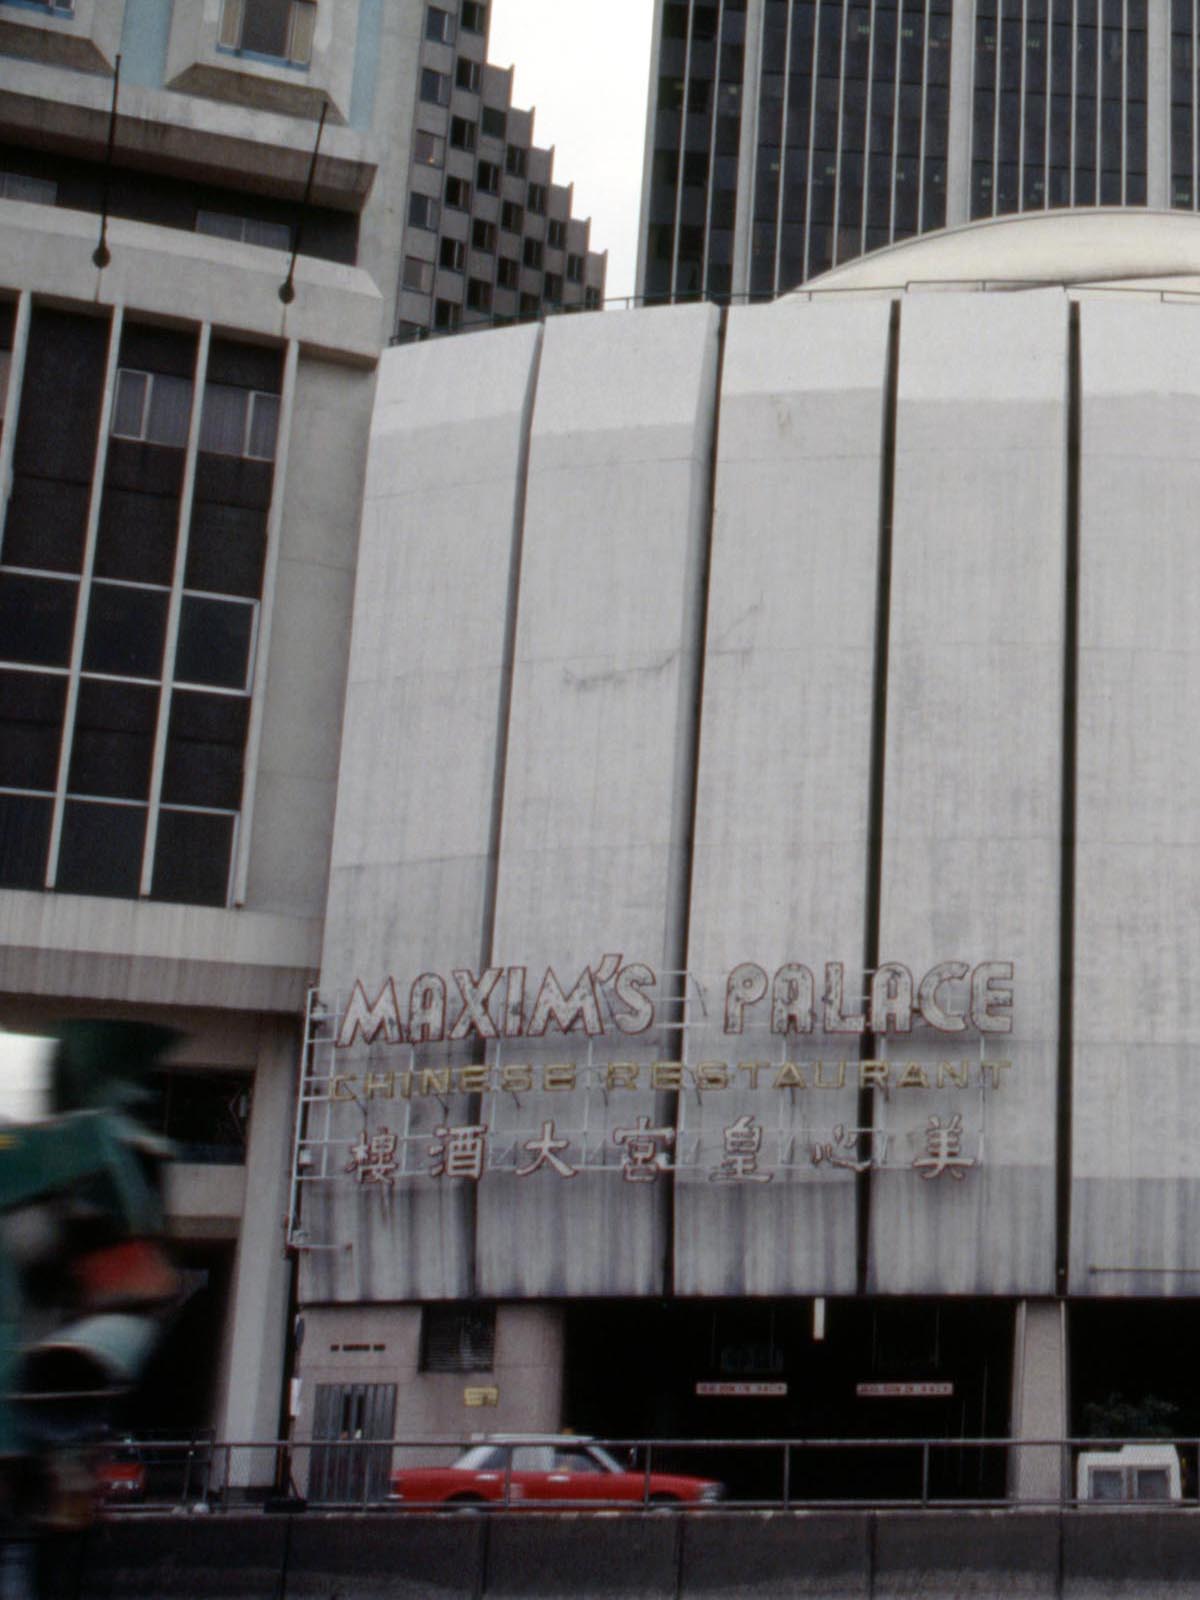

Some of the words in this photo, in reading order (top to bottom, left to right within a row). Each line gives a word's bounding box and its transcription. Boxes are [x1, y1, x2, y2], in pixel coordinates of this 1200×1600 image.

[334, 953, 656, 1047] MAXIM'S
[723, 960, 1014, 1035] PALACE
[327, 1063, 576, 1103] CHINESE
[606, 1057, 1012, 1093] RESTAURANT
